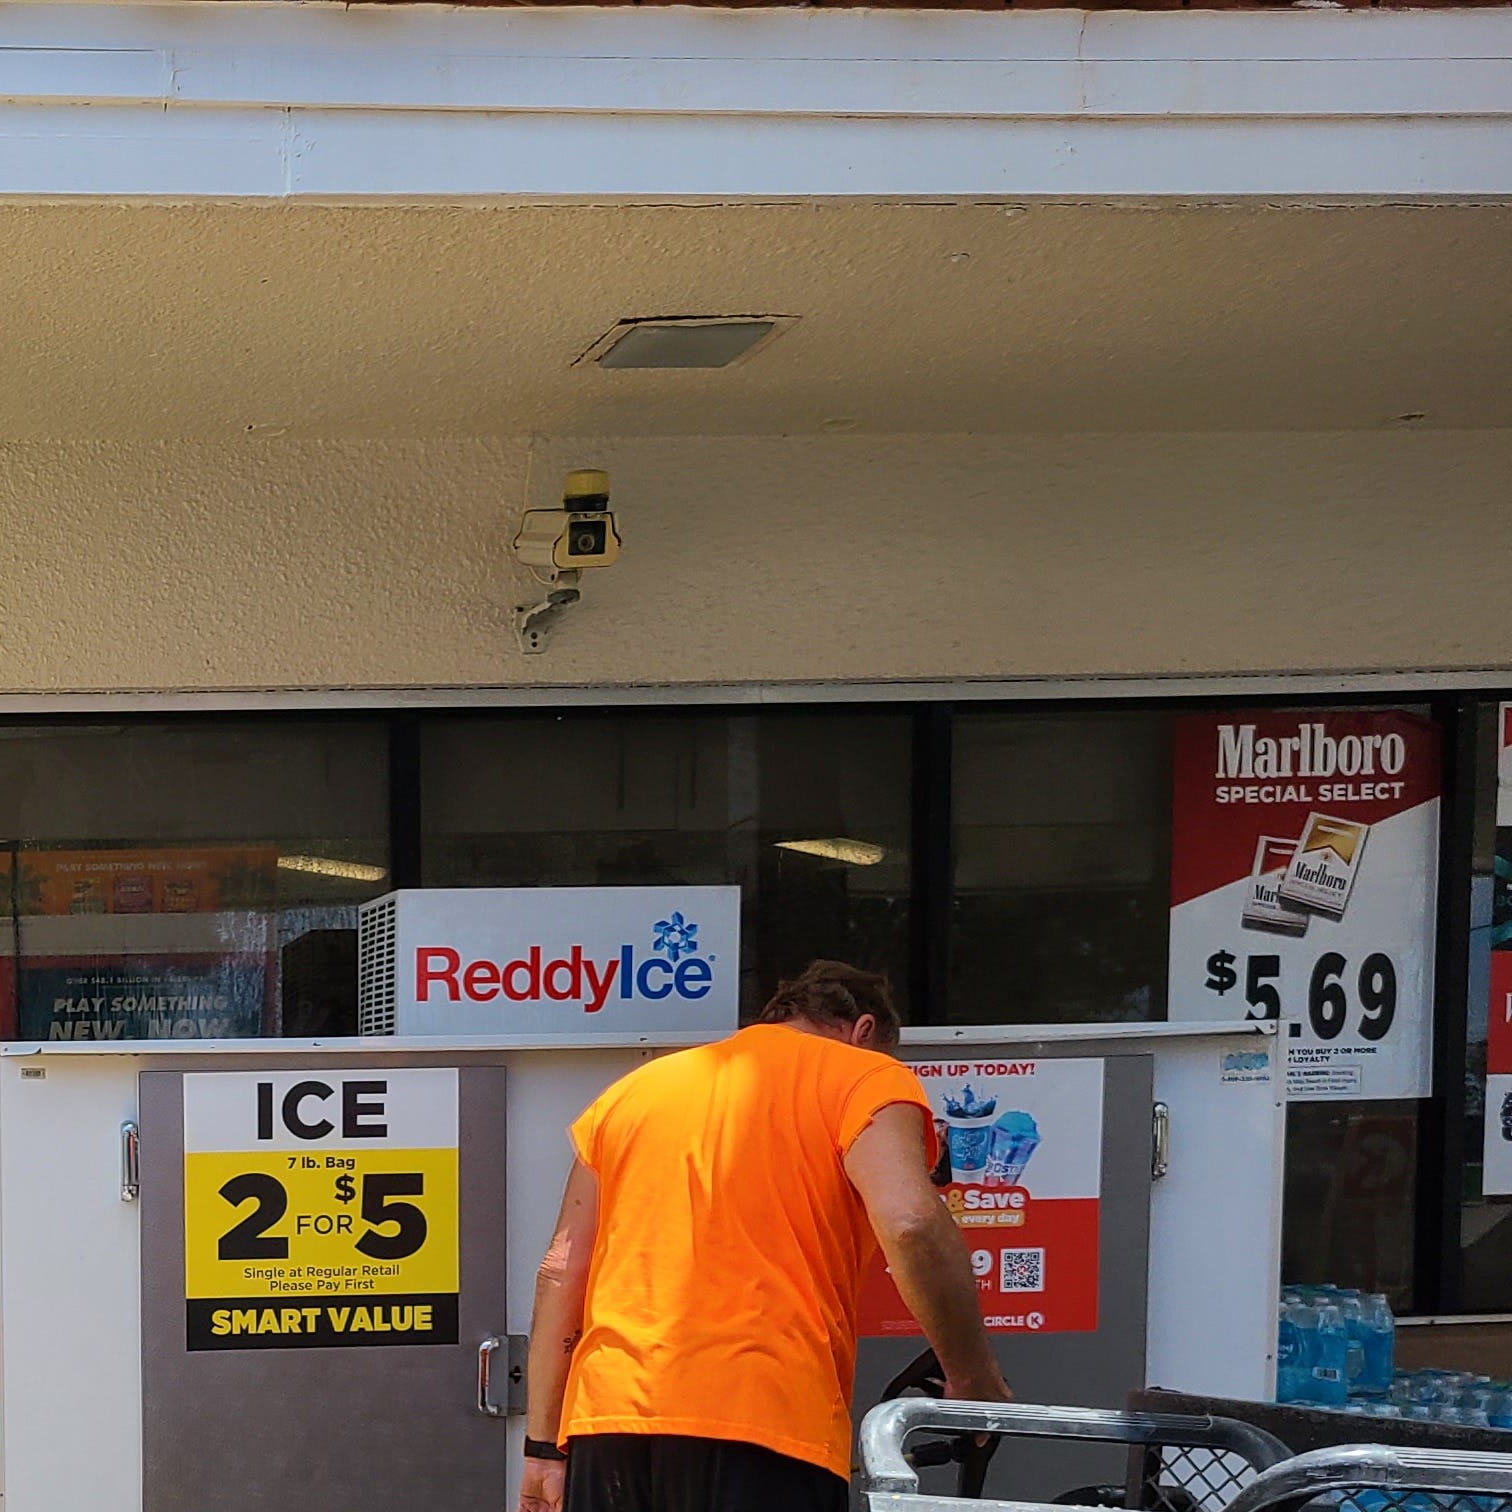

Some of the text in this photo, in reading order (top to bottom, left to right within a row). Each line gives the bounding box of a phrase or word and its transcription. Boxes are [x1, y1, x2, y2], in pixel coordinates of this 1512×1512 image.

[1215, 723, 1405, 778] Marlboro
[1215, 782, 1404, 803] SPECIAL SELECT
[66, 977, 87, 985] OER
[415, 944, 713, 1013] ReddyIce
[54, 995, 229, 1013] PLAY SOMETHING
[948, 1064, 969, 1077] UP
[974, 1063, 1035, 1076] TODAY!
[257, 1080, 388, 1140] ICE
[288, 1157, 356, 1170] 7 lb. Bag
[218, 1172, 289, 1260] 2
[296, 1215, 353, 1235] FOR
[961, 1213, 1020, 1225] every day
[244, 1265, 400, 1279] Single at Regular Retail
[269, 1279, 375, 1293] Please Pay First
[211, 1305, 433, 1335] SMART VALUE
[984, 1315, 1024, 1327] CIRCLE
